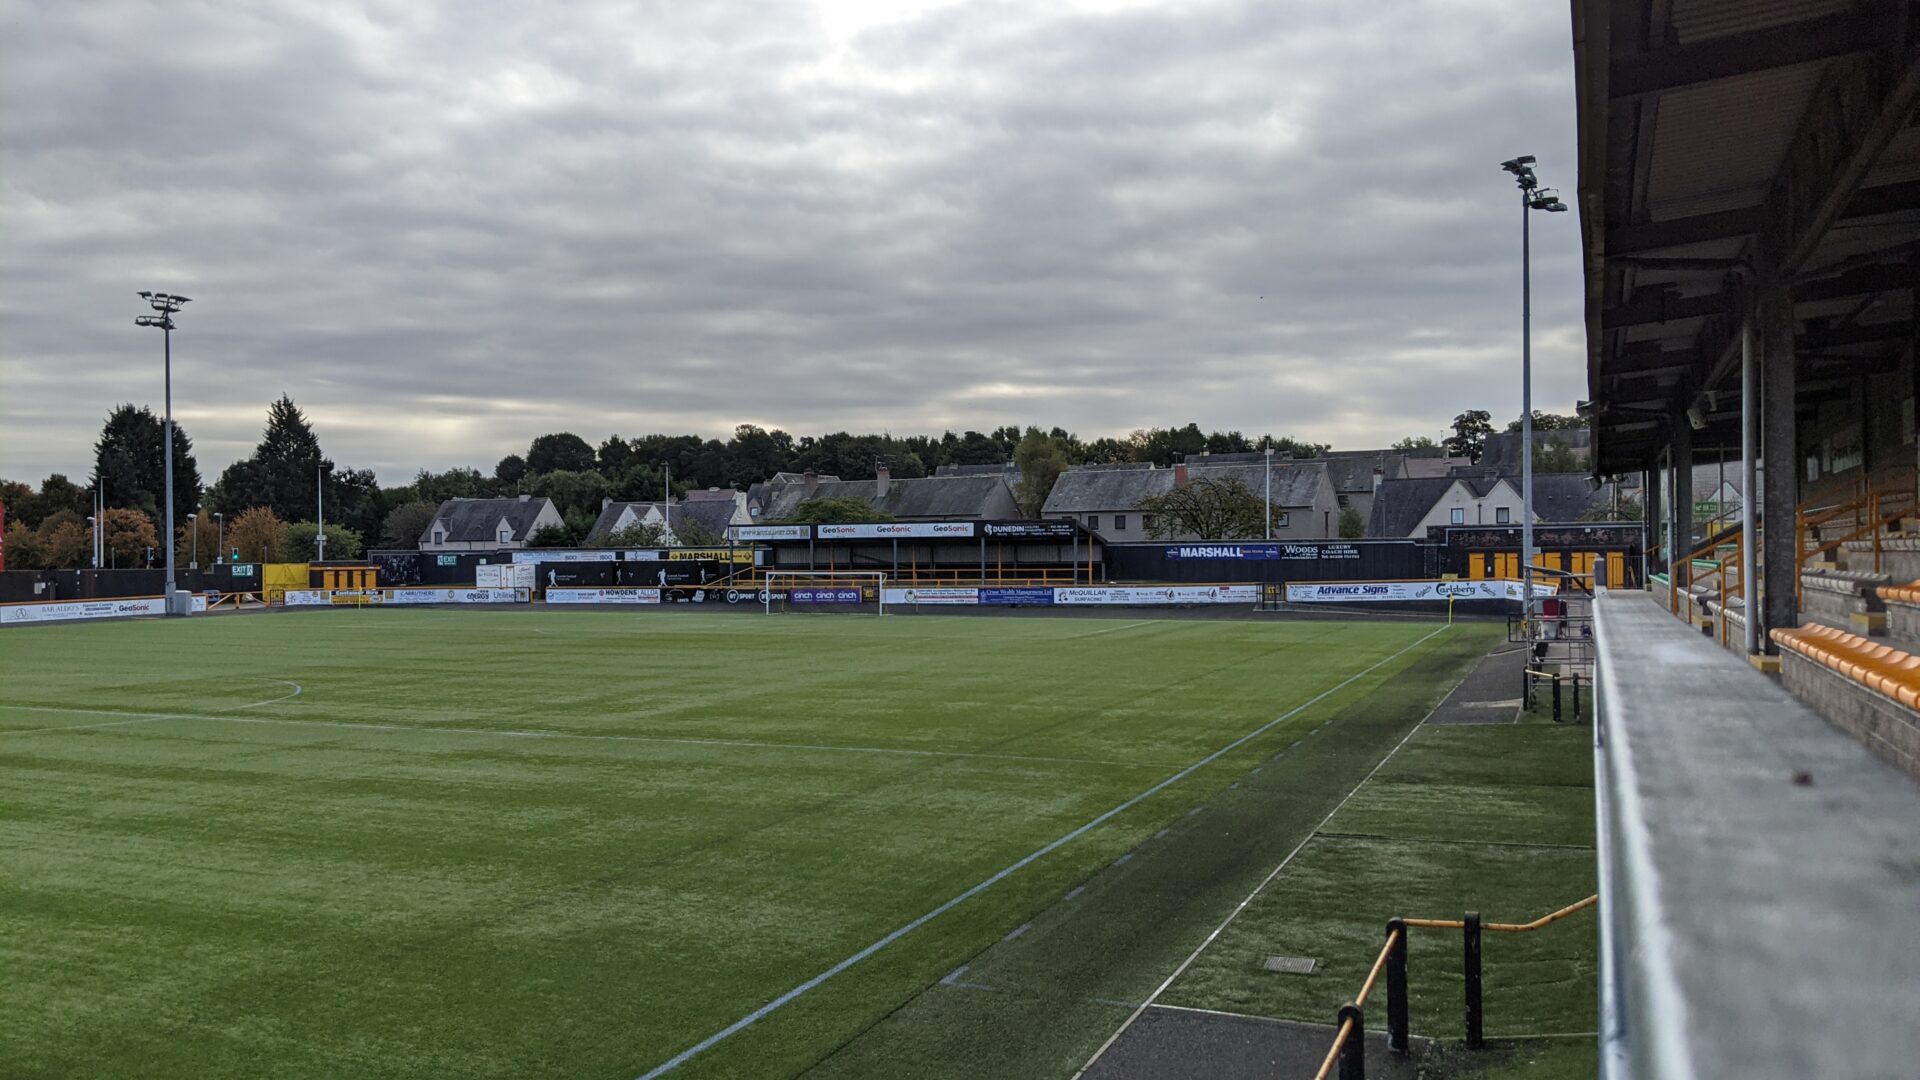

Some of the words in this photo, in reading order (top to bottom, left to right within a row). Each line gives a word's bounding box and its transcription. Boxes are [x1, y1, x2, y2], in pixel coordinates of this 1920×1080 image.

[822, 526, 856, 534] GeoSonic
[877, 525, 912, 533] GeoSonic
[993, 525, 1025, 533] DUNEDIN
[680, 552, 731, 561] MARSHALL
[1180, 547, 1244, 558] MARSHALL
[1317, 585, 1360, 595] Advance
[1362, 585, 1389, 596] Signs
[1436, 583, 1476, 596] Carlsberg
[794, 591, 813, 599] cinch
[816, 591, 835, 599] cinch
[838, 591, 857, 599] cinch
[118, 604, 150, 612] GeoSonic
